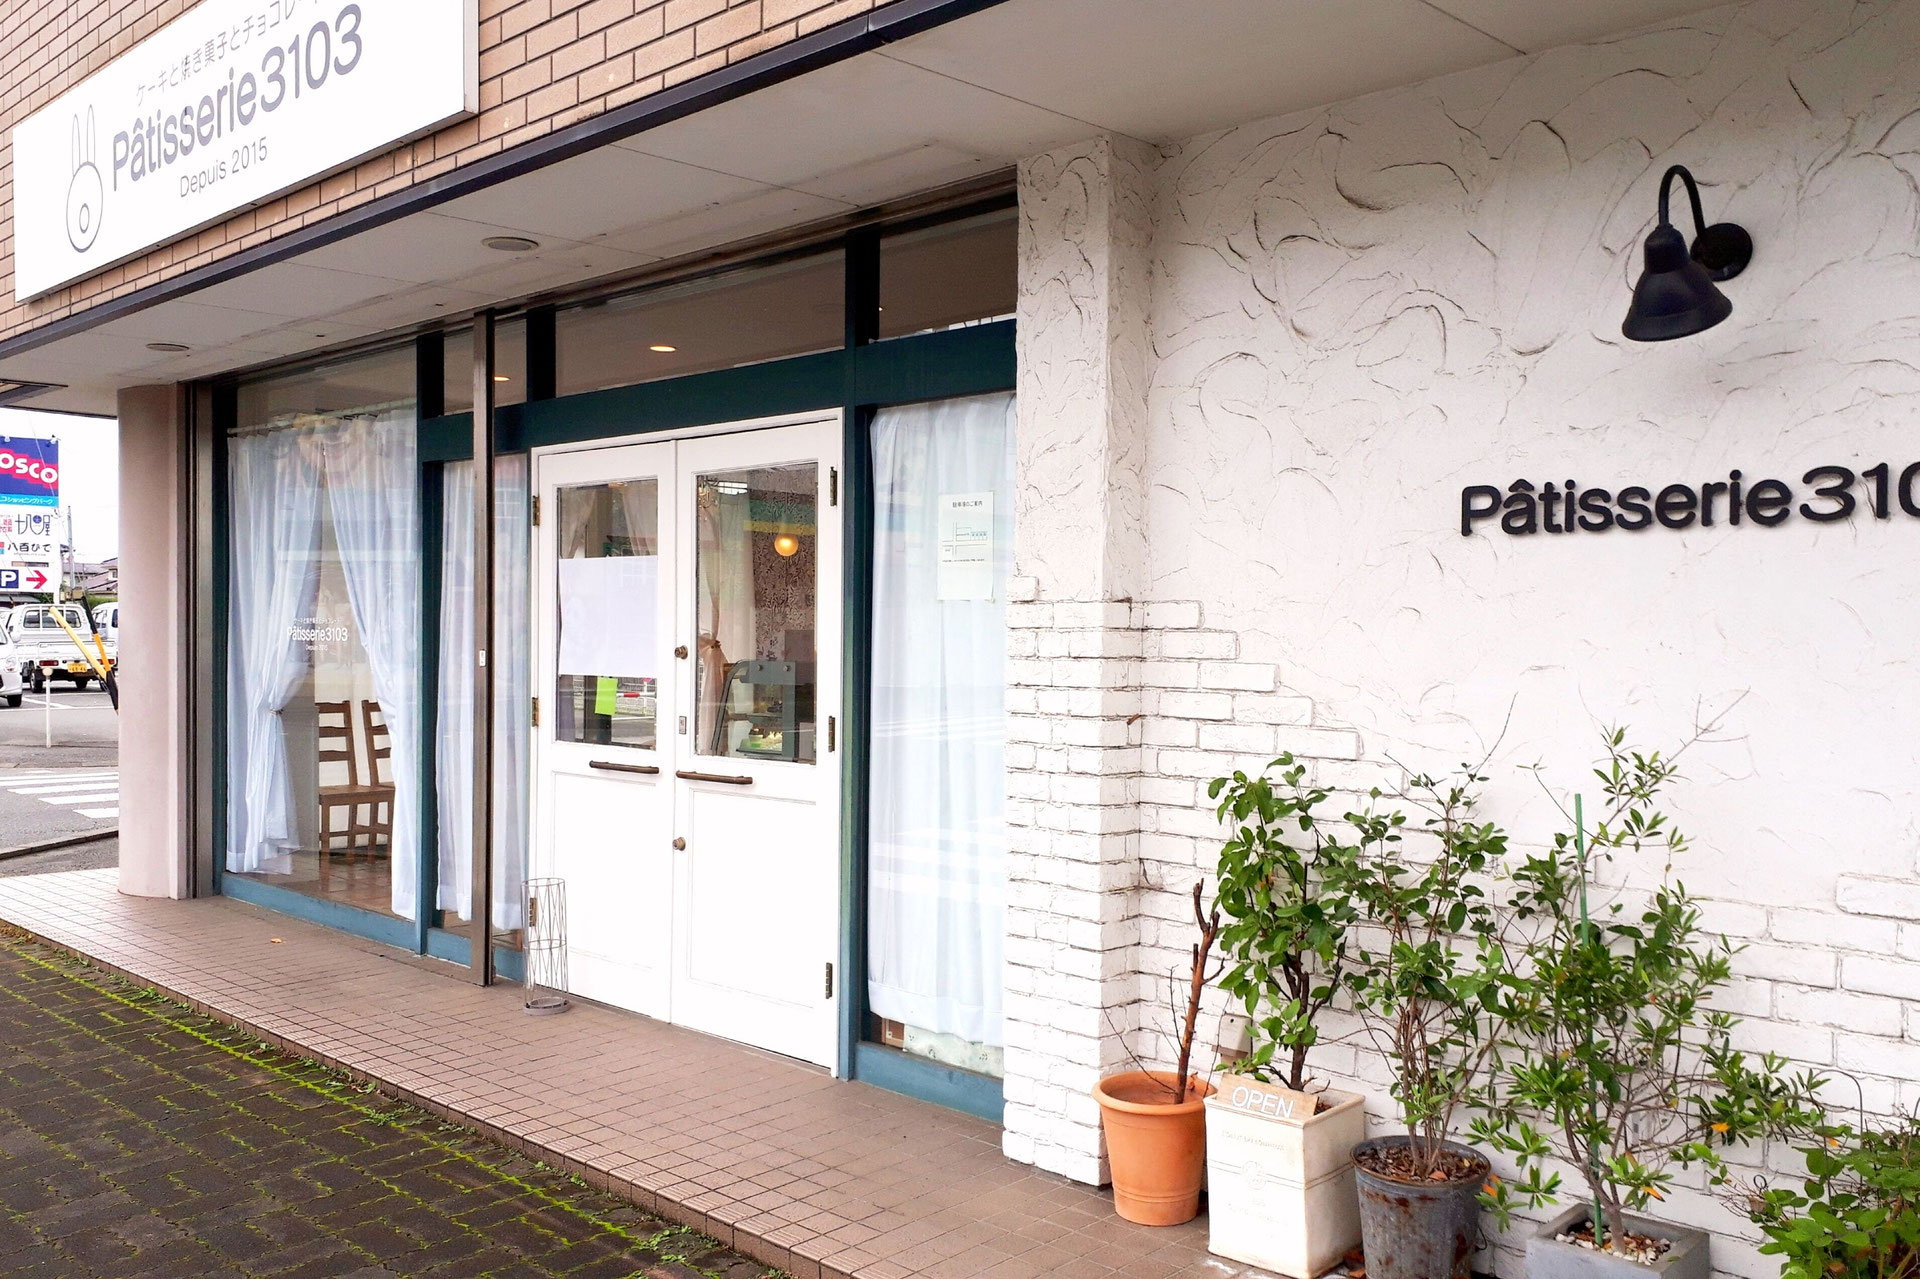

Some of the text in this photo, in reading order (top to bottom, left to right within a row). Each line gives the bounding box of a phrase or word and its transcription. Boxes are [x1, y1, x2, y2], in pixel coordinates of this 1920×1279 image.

[136, 0, 318, 106] ケーキと焼き菓子とチョコレ
[113, 3, 362, 191] Pâtisserie3103
[180, 136, 268, 198] Depuis 2015
[1, 571, 17, 587] P
[1231, 1085, 1294, 1118] OPEN
